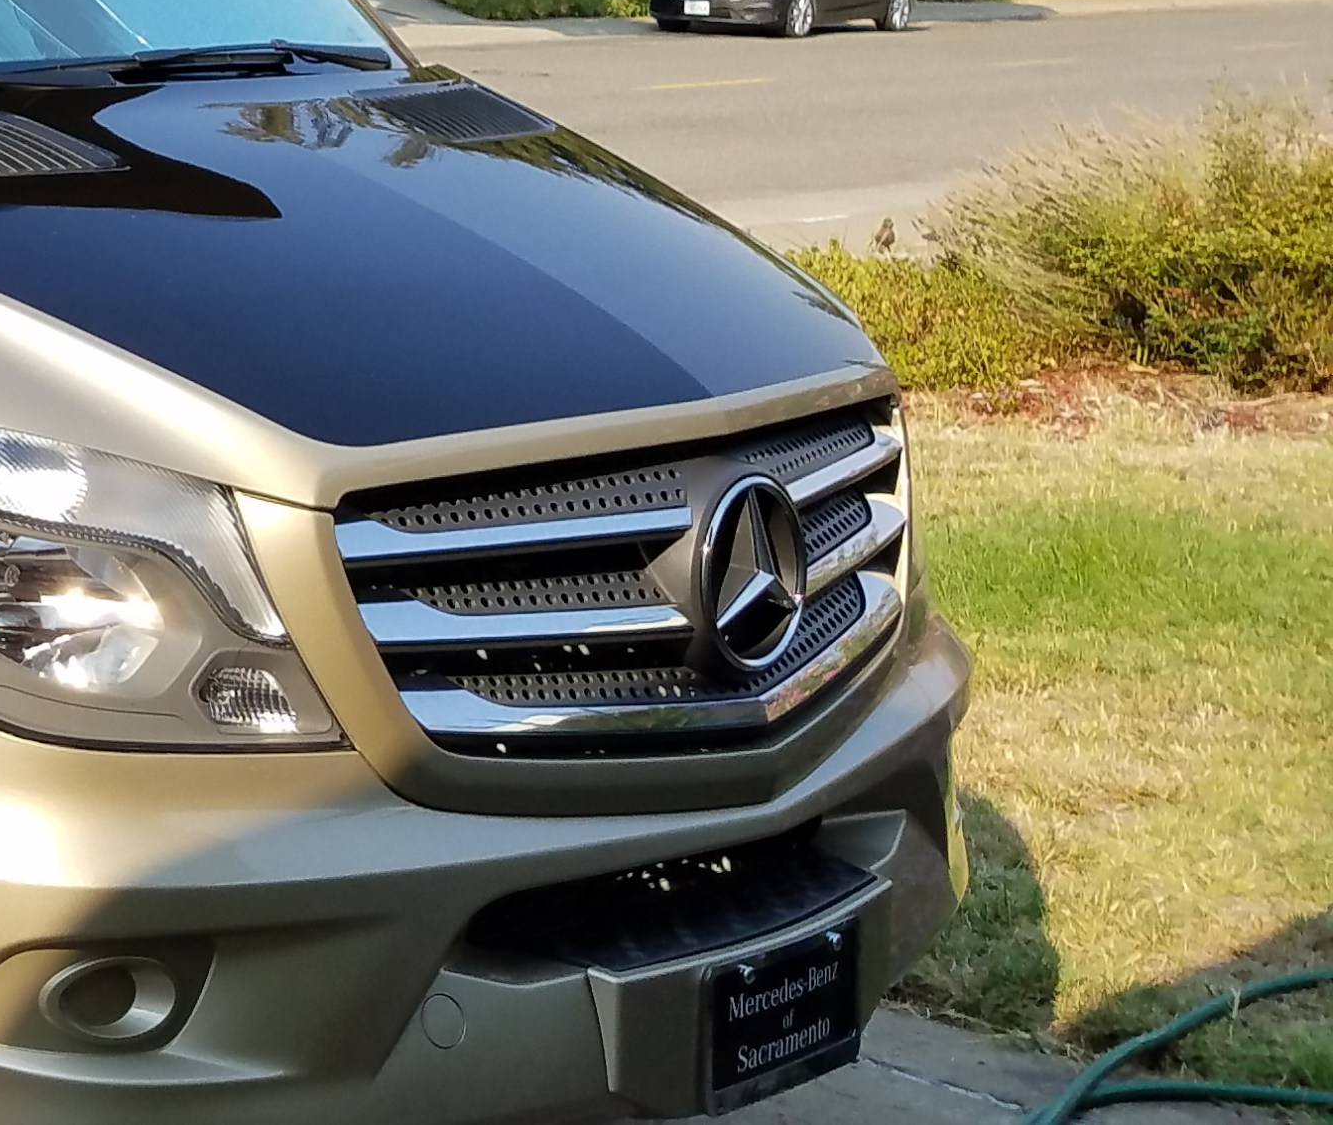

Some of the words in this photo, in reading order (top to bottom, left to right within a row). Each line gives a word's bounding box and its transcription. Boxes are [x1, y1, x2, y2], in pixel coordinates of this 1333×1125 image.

[728, 961, 839, 1022] Mercedes-Benz
[783, 1008, 795, 1028] of
[737, 1017, 830, 1073] Sacramento
